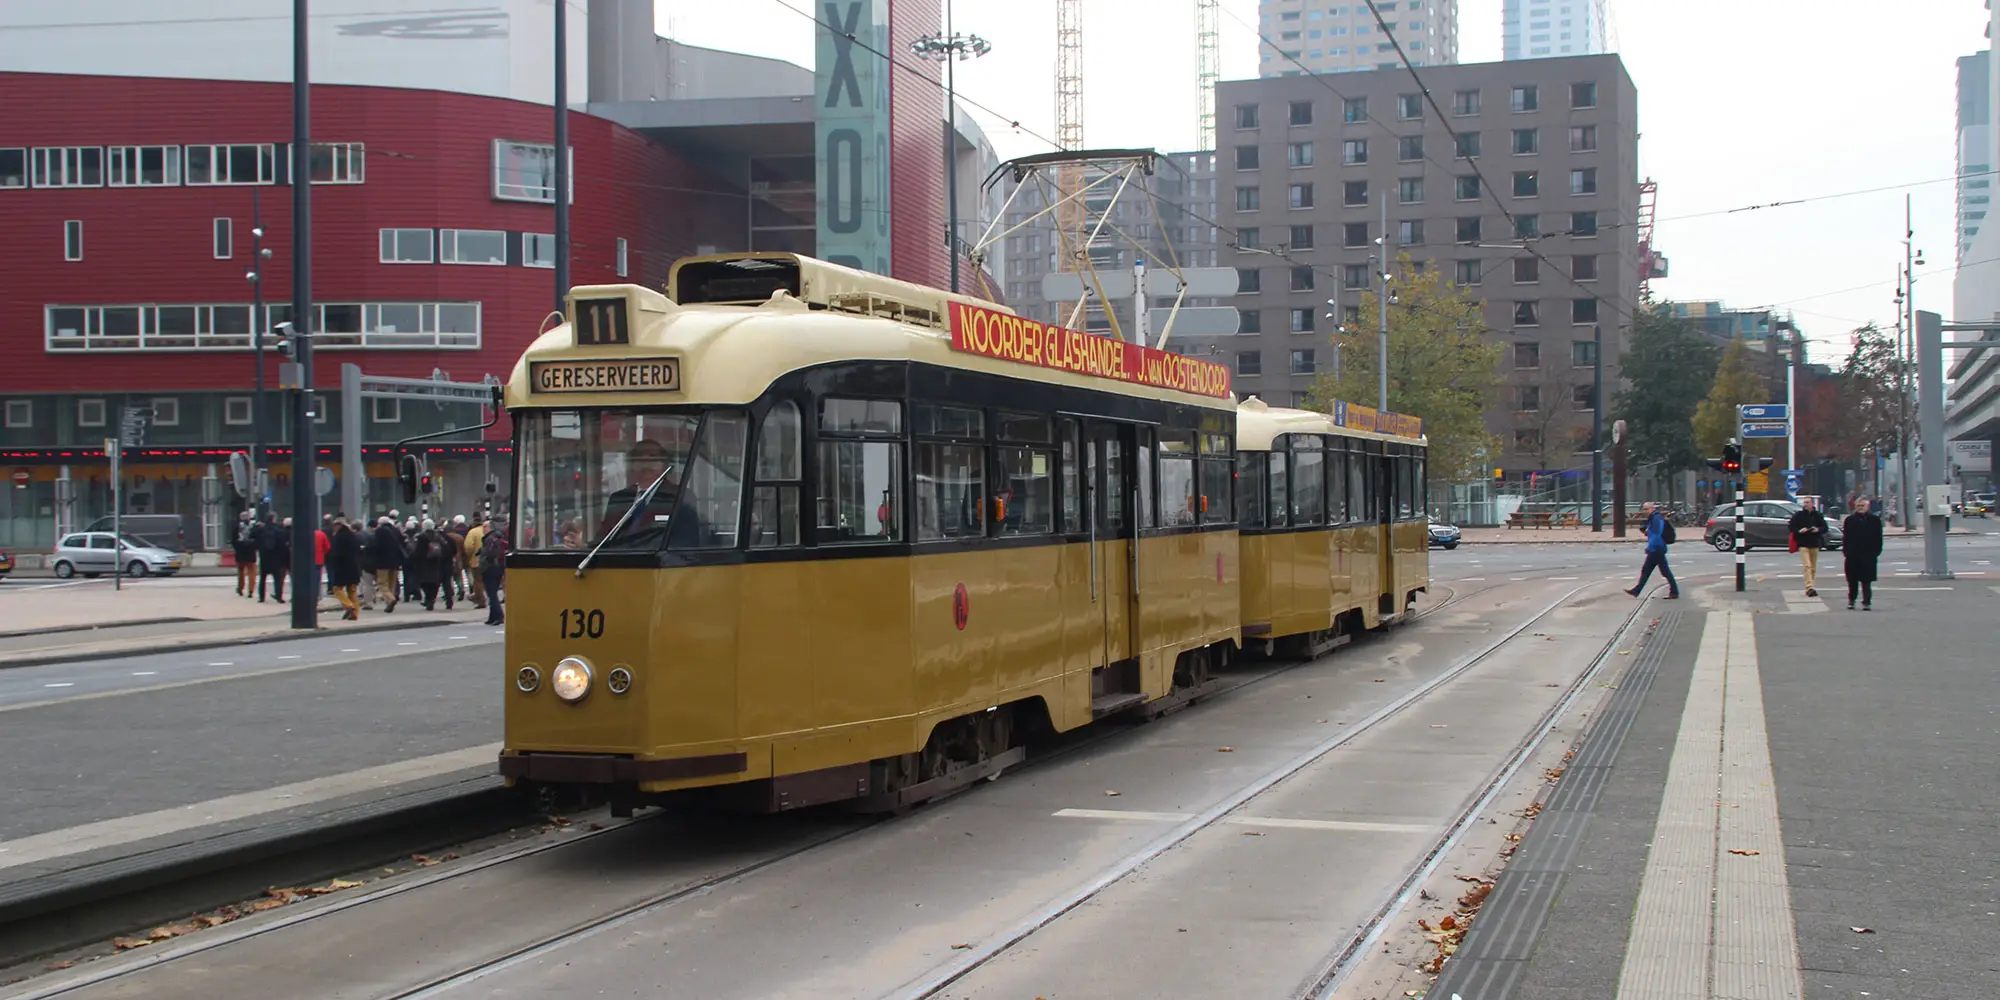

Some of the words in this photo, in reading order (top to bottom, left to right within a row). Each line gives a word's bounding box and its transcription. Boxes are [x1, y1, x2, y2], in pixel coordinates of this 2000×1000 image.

[824, 3, 863, 276] XO
[590, 305, 617, 342] 11
[960, 305, 1043, 364] NOORDER
[1163, 353, 1226, 395] OOSTENDORP
[541, 364, 673, 389] GERESERVEERD
[559, 608, 605, 639] 130
